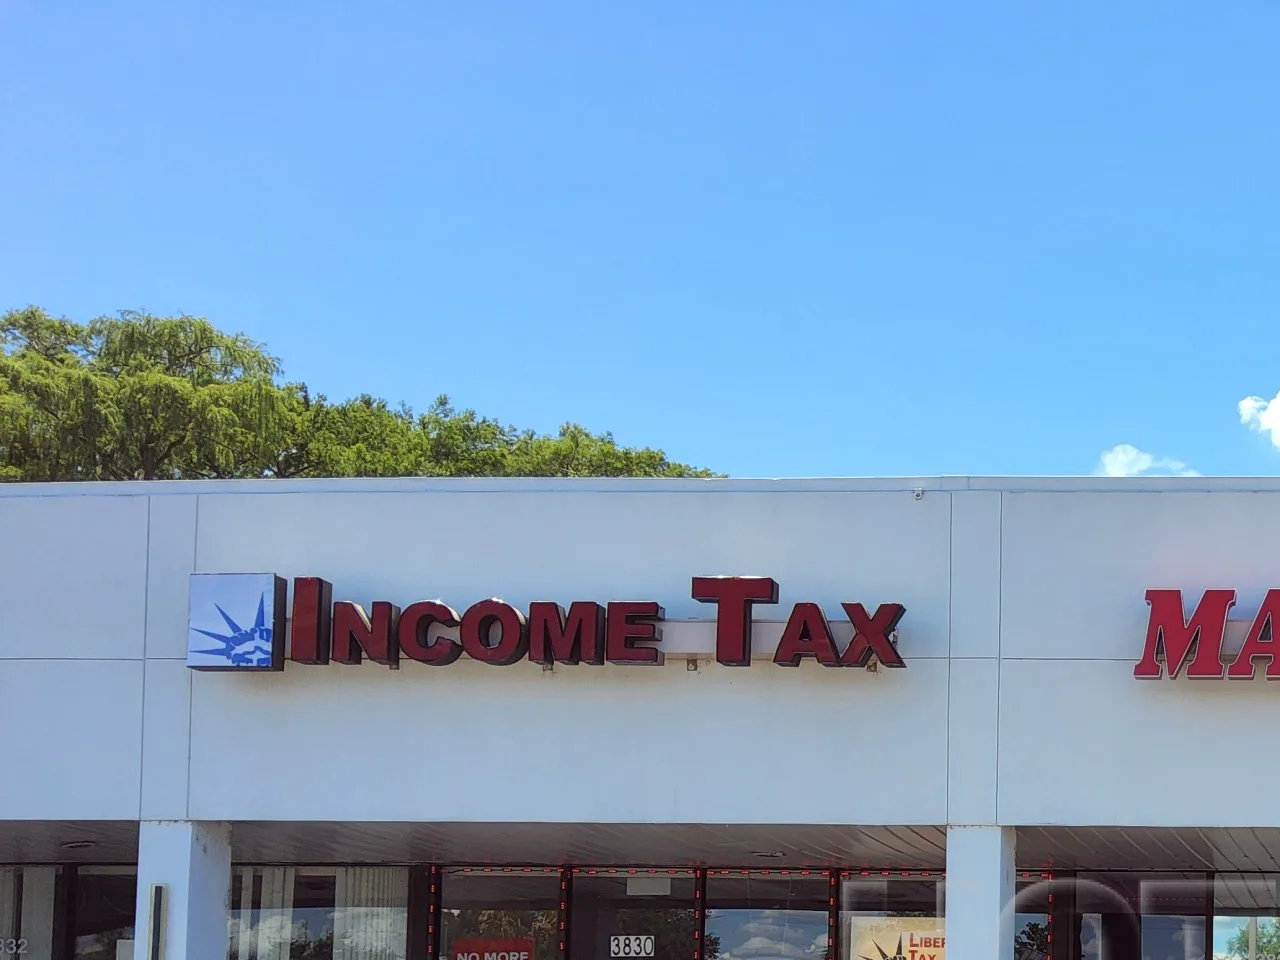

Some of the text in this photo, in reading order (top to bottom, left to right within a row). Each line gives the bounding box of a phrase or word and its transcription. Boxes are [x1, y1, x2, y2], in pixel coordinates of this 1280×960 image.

[291, 576, 907, 669] INCOME TAX
[611, 936, 654, 956] 3830
